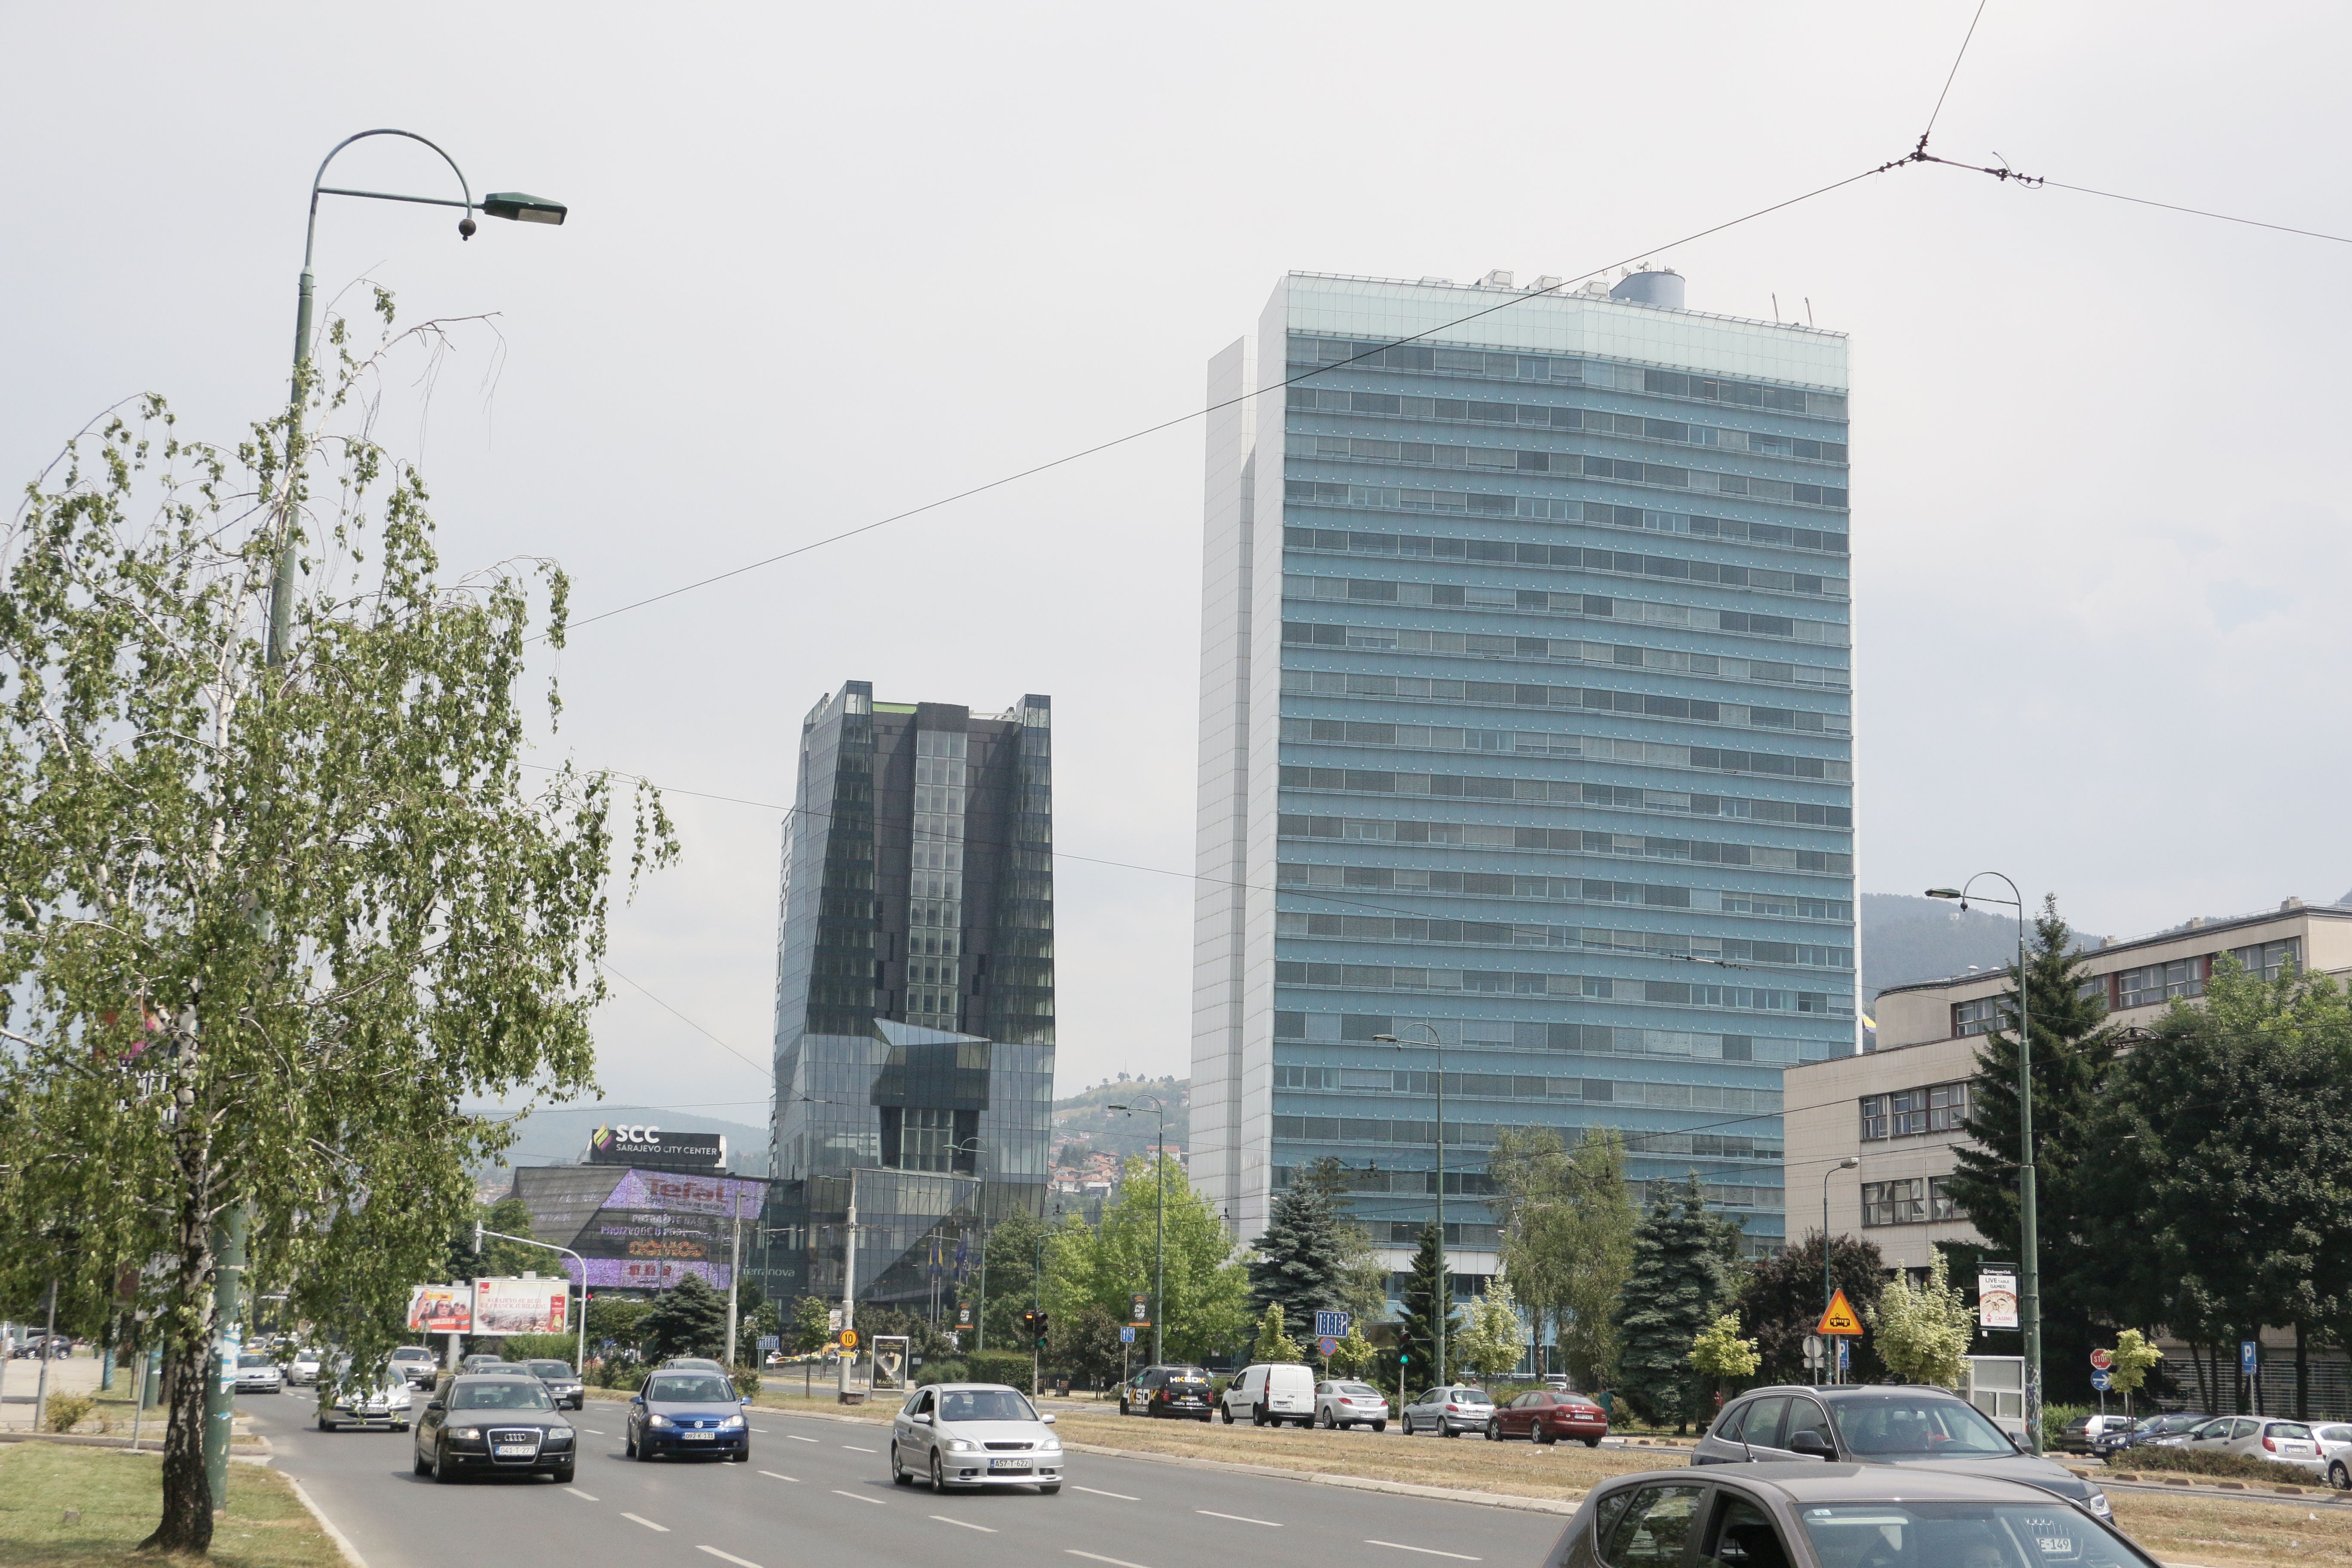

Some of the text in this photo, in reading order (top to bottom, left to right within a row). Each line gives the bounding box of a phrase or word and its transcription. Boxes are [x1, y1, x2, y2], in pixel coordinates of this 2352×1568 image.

[616, 1124, 660, 1143] SCC
[616, 1143, 717, 1155] SARAJEVO CITY CENTER
[645, 1178, 729, 1204] Tefal
[845, 1334, 853, 1344] 10
[2244, 1345, 2251, 1362] P
[2039, 1539, 2069, 1550] E-149
